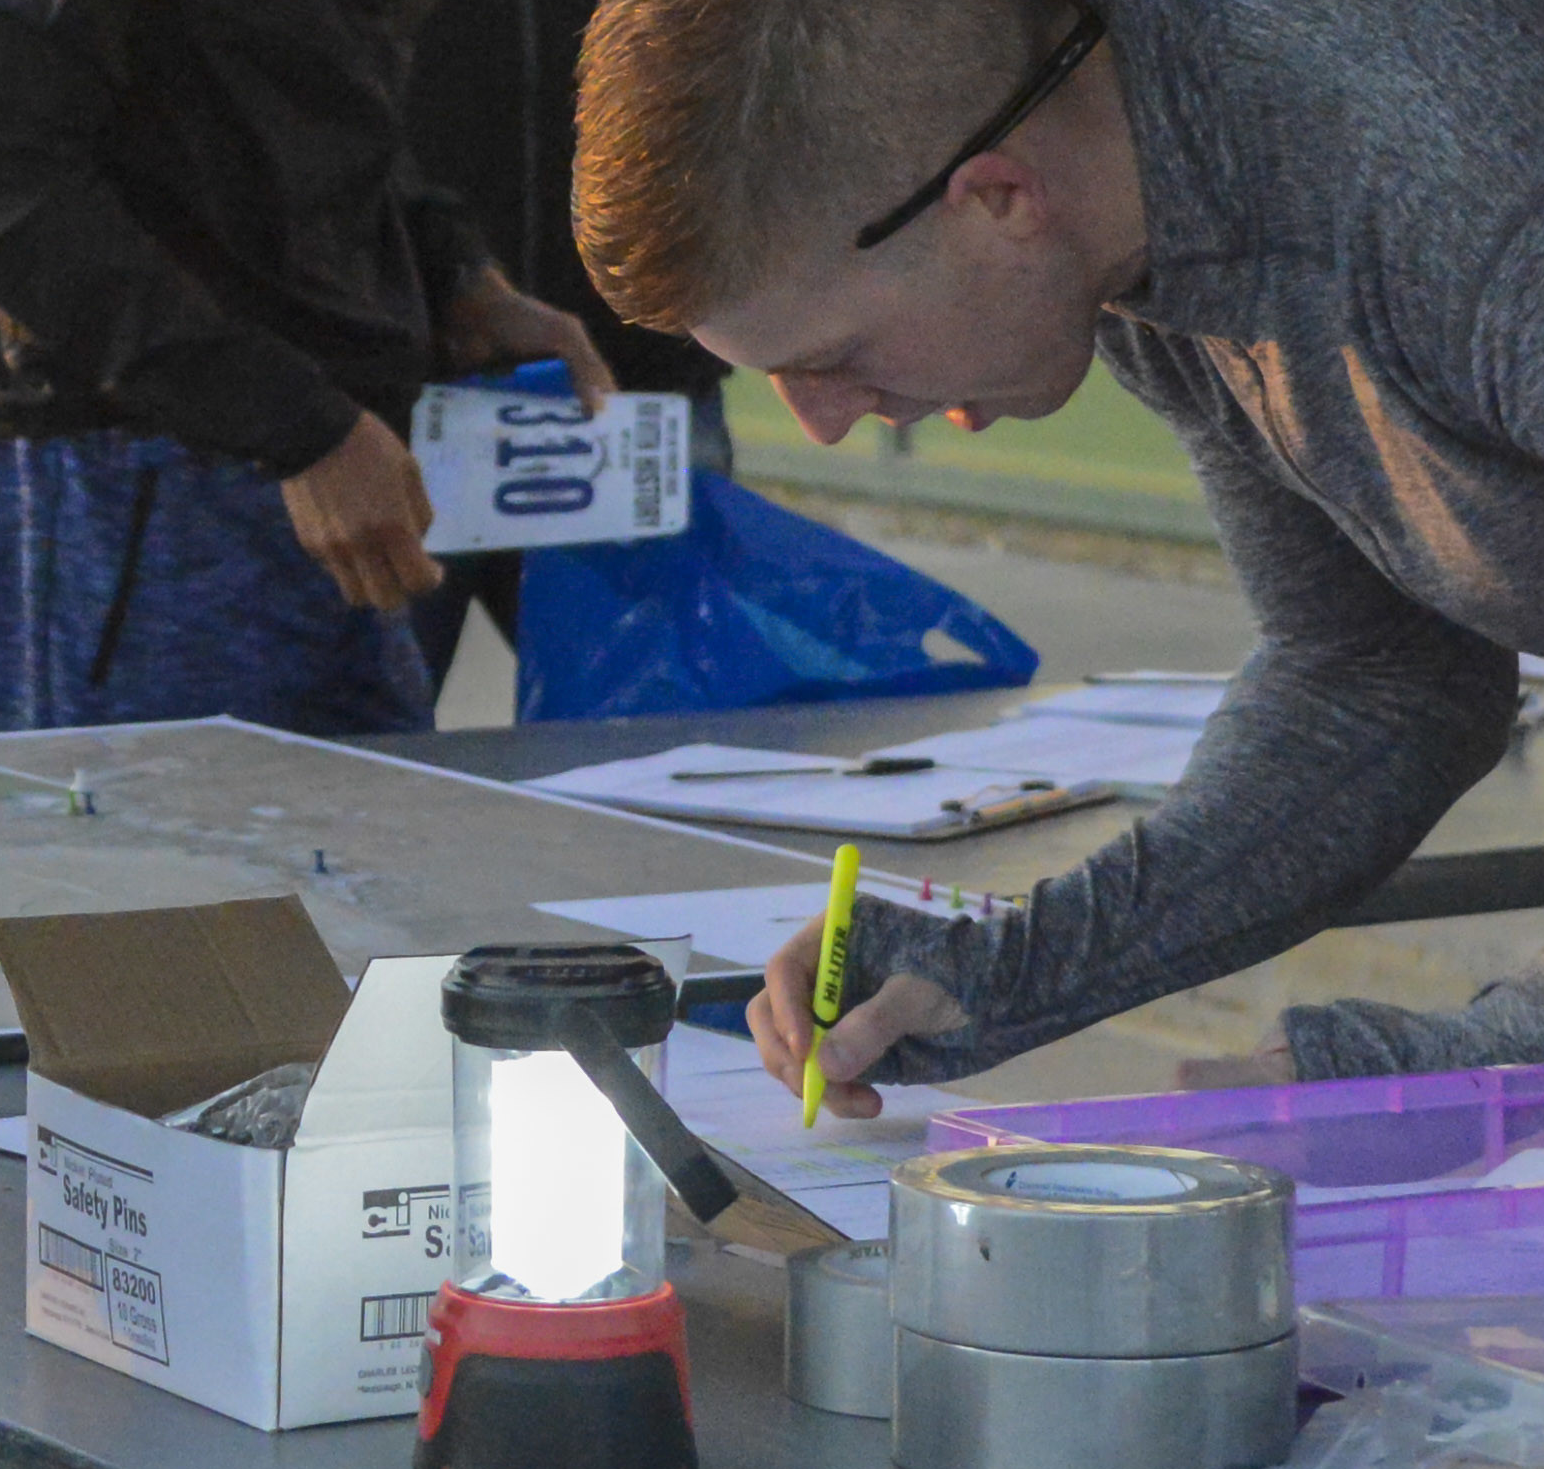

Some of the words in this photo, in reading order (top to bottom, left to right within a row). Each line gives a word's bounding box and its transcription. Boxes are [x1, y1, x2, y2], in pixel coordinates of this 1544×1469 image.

[493, 403, 594, 516] 310
[63, 1173, 108, 1230] Safety
[113, 1195, 147, 1237] Pins
[112, 1267, 156, 1305] 83200
